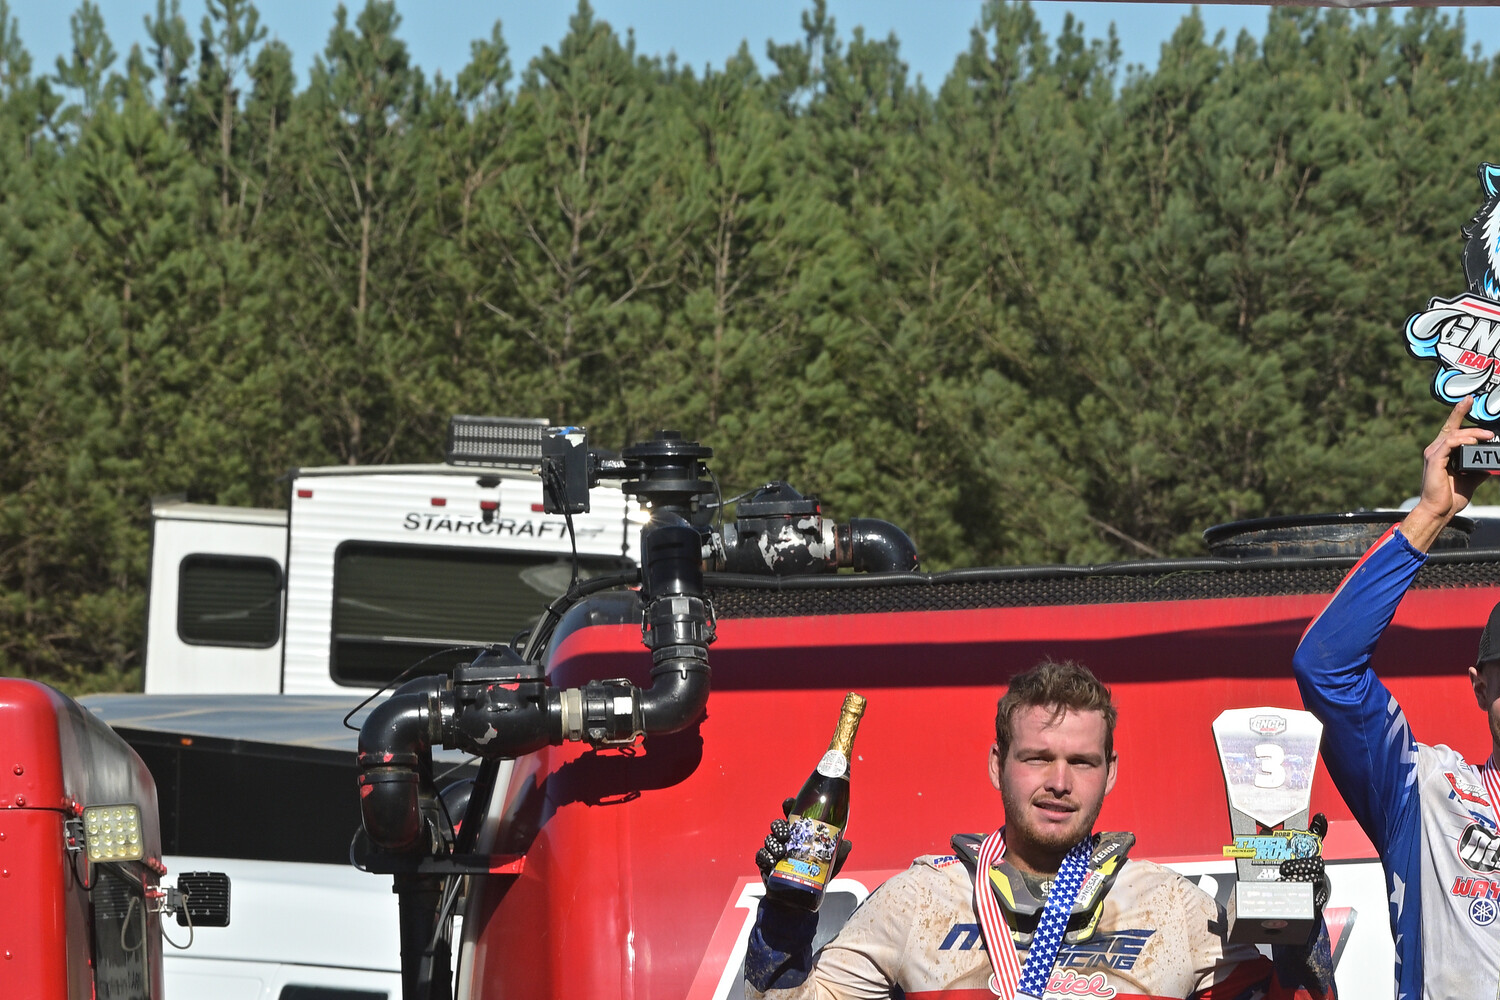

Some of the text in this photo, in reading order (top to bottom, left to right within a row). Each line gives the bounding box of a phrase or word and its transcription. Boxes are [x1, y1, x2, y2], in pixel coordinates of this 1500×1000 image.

[403, 512, 570, 539] STARCRAFT
[1254, 743, 1286, 788] 3
[1092, 841, 1121, 864] KENDA
[1235, 836, 1288, 849] TIGER
[1254, 847, 1293, 860] RUN
[1082, 872, 1101, 898] NISSAN
[1055, 952, 1138, 971] ACING
